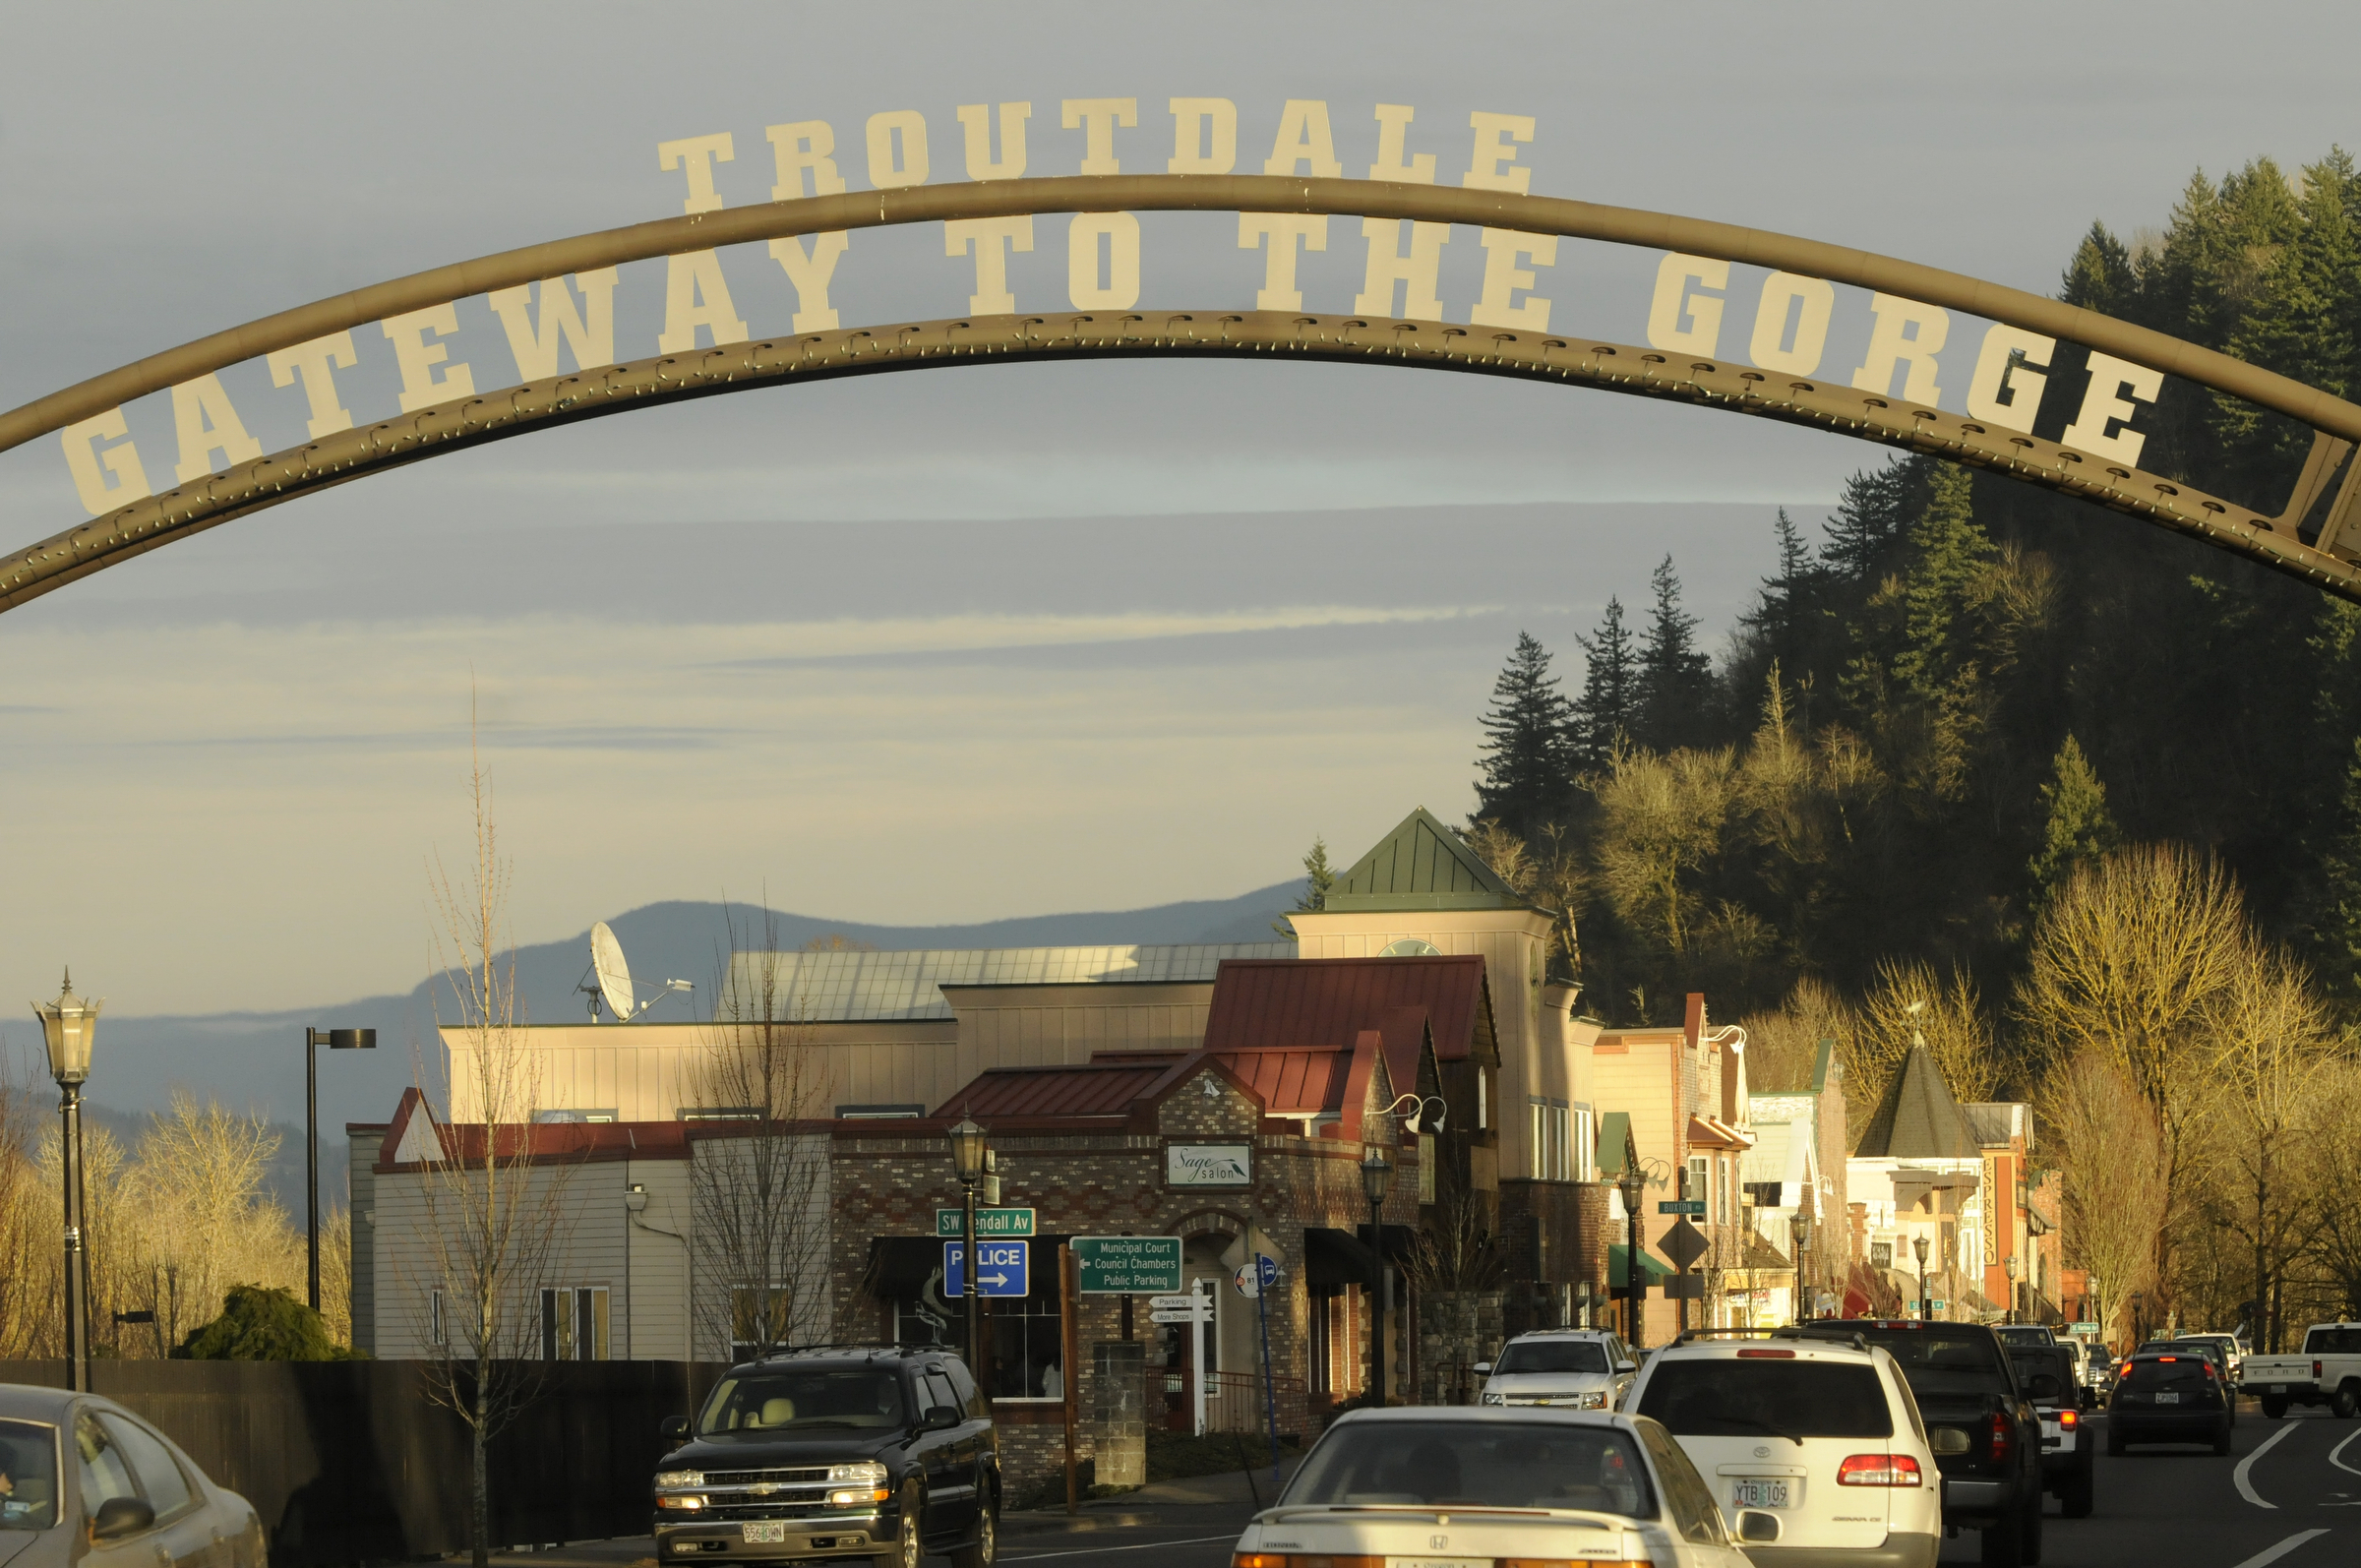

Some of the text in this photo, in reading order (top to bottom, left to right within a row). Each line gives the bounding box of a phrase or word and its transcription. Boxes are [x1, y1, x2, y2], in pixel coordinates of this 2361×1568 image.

[658, 96, 1536, 213] TROUTDALE
[61, 211, 2164, 515] GATEWAY TO THE GORGE
[1175, 1148, 1215, 1182] Sage
[1201, 1167, 1234, 1178] salon
[1664, 1203, 1692, 1213] BUXTON
[1983, 1159, 1994, 1264] ESPRESSO
[942, 1214, 1029, 1231] SW endall Av
[1101, 1242, 1171, 1255] Municipal Court
[951, 1249, 1020, 1266] PLICE
[1095, 1258, 1177, 1269] Council Chambers
[1104, 1275, 1168, 1289] Public Parking
[1736, 1485, 1786, 1501] YTB 109
[745, 1527, 760, 1538] 556
